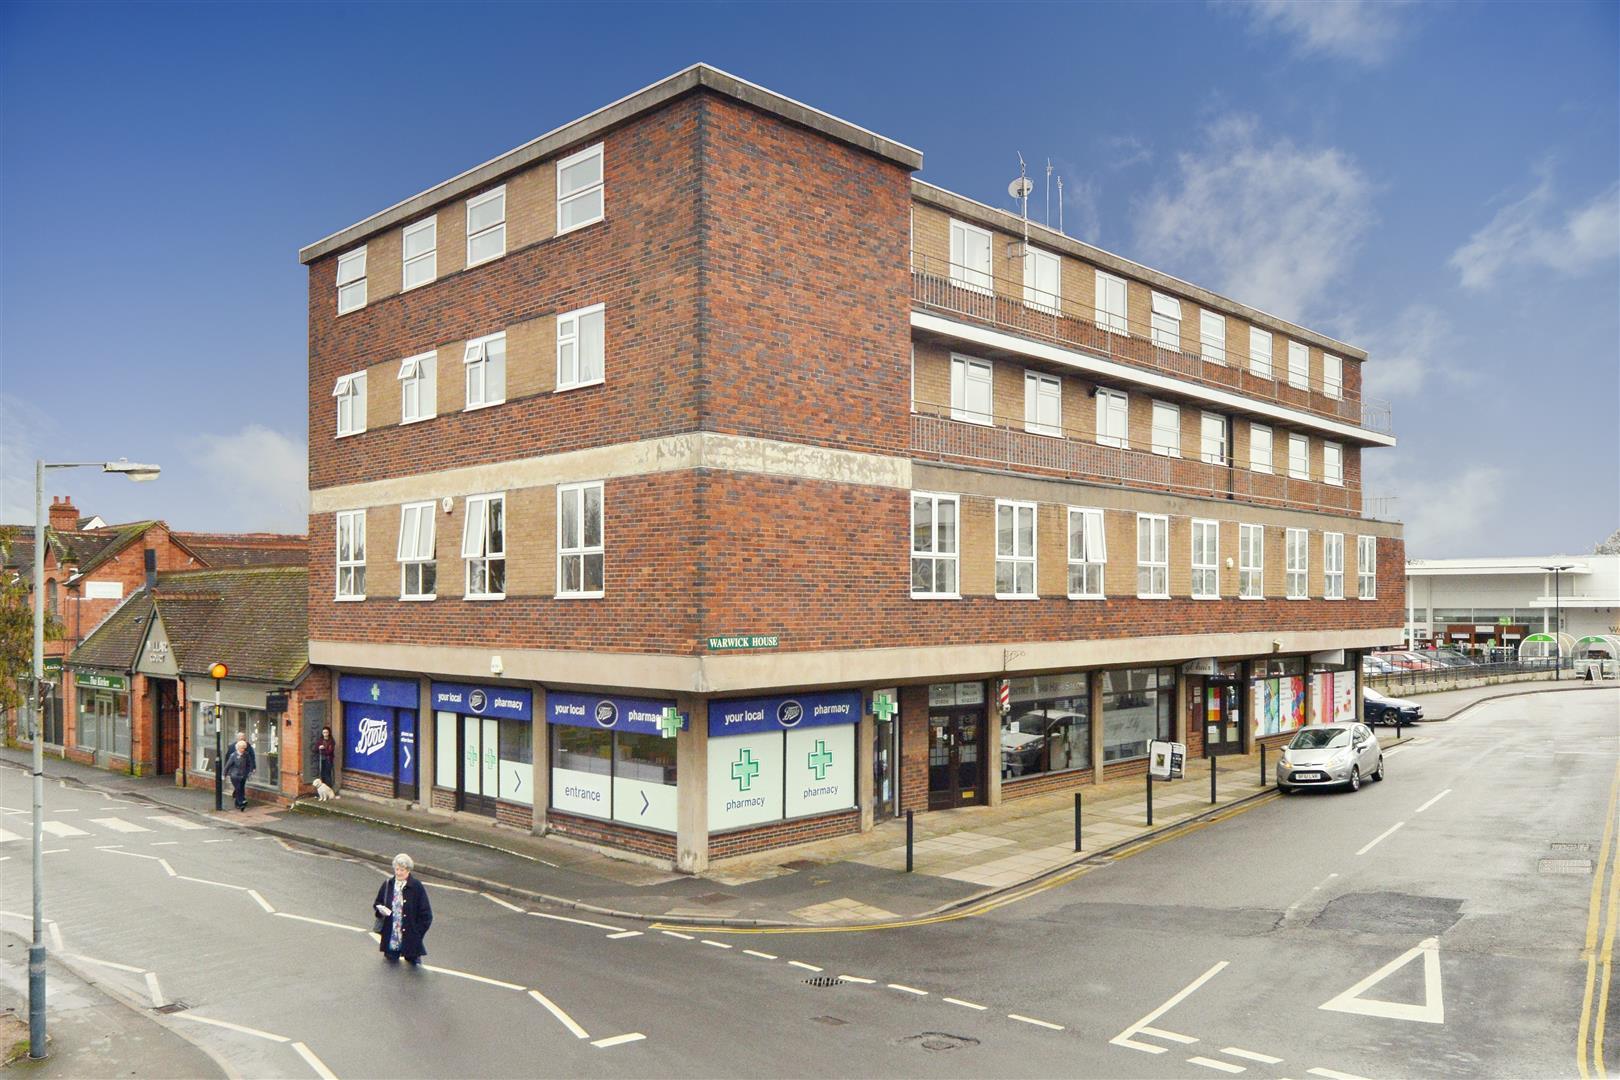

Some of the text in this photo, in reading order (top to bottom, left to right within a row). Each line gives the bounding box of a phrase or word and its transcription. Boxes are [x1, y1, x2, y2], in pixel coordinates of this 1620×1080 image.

[709, 636, 777, 648] WARWICK HOUSE
[438, 693, 449, 703] your
[449, 692, 462, 703] local
[494, 697, 523, 711] pharmacy
[555, 704, 569, 715] your
[569, 703, 585, 716] local
[724, 713, 744, 726] your
[744, 709, 764, 722] local
[814, 704, 850, 717] pharmacy
[354, 717, 388, 756] Boots
[564, 785, 602, 802] entrance
[803, 785, 839, 799] pharmacy
[726, 796, 766, 811] pharmacy
